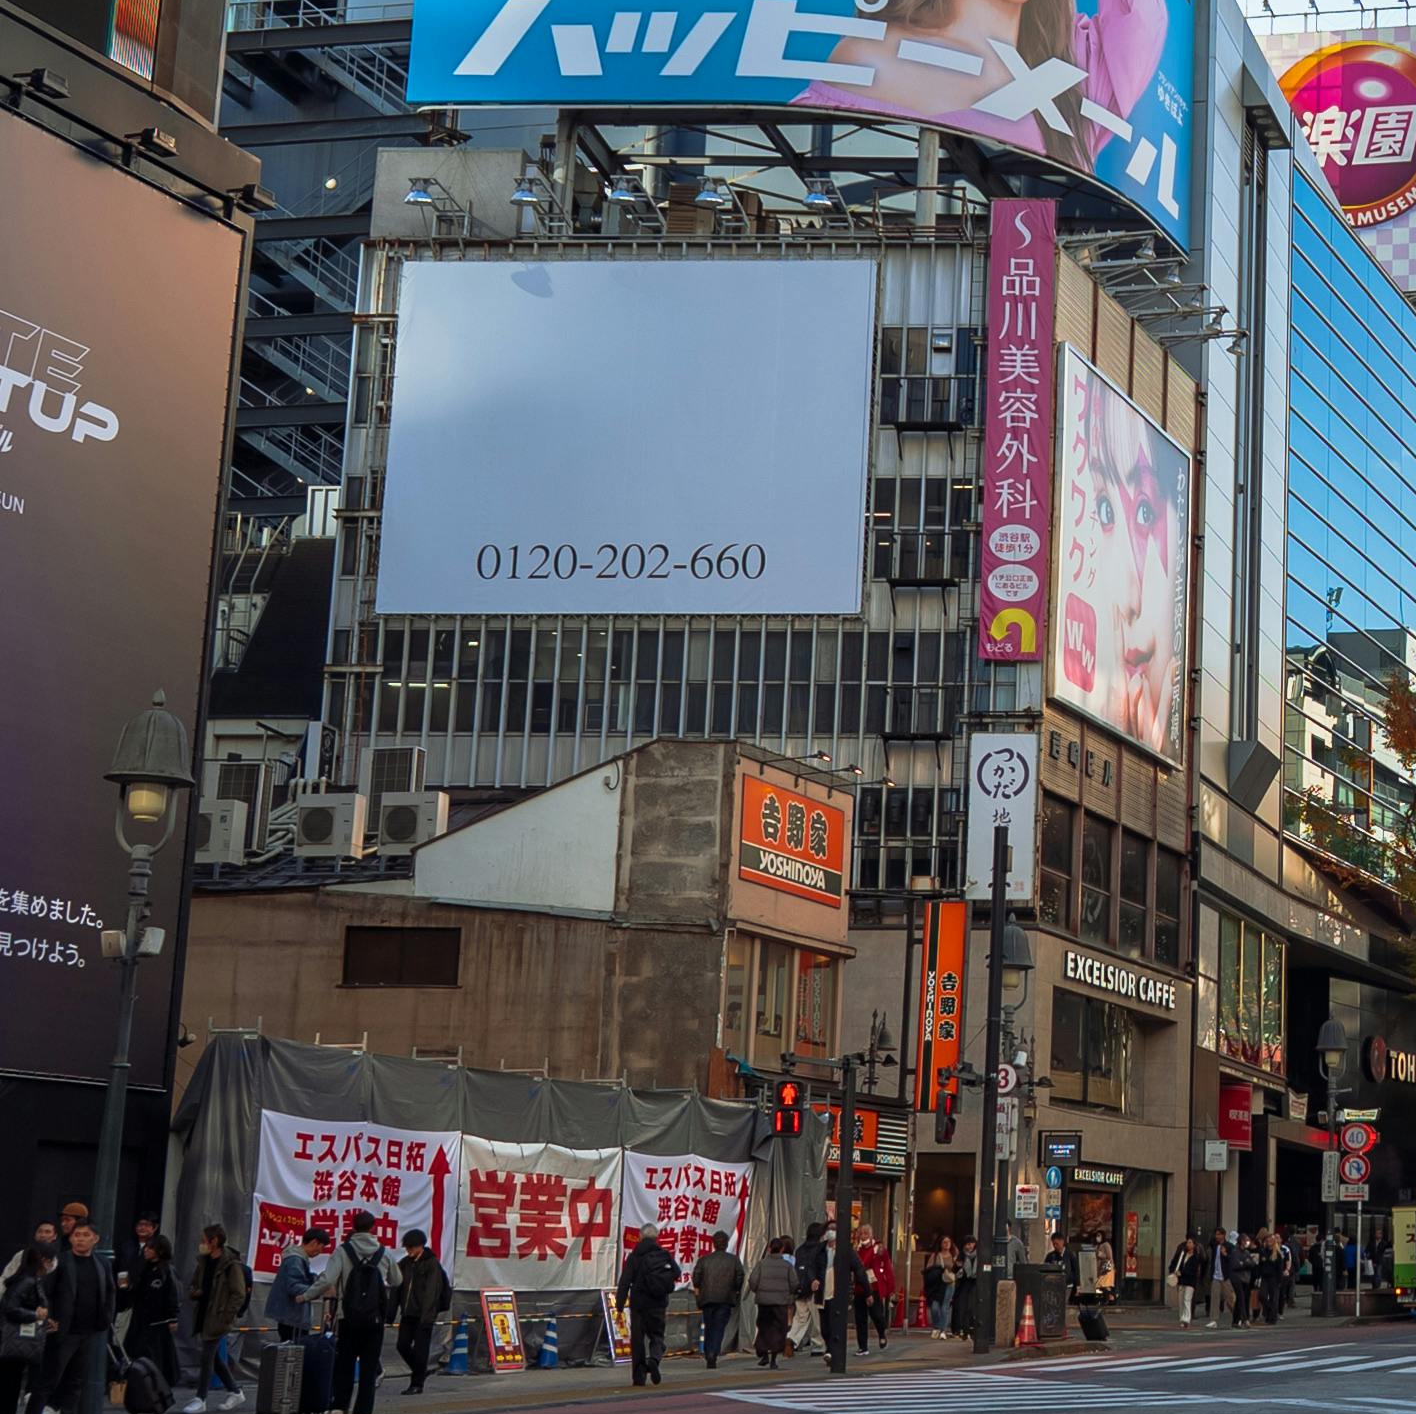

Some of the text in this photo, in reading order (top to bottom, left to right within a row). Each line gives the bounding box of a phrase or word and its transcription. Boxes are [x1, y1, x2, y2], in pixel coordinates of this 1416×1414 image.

[994, 256, 1042, 520] 品川美容外科
[1069, 374, 1089, 583] ワクワク
[476, 543, 767, 581] 0120-202-660
[759, 850, 826, 890] YOSHINOYA
[1066, 950, 1137, 998] EXCELSIOR
[924, 970, 936, 1042] YOSHINOYA
[937, 971, 960, 1041] 吉野家
[294, 1132, 427, 1173] エスパス日拓
[1347, 1131, 1364, 1144] 40
[312, 1169, 402, 1207] 渋谷本館
[644, 1162, 737, 1197] エスパス日拓
[1074, 1168, 1105, 1183] EXCELSIOR
[465, 1166, 614, 1262] 営業中
[656, 1193, 721, 1226] 渋谷本館
